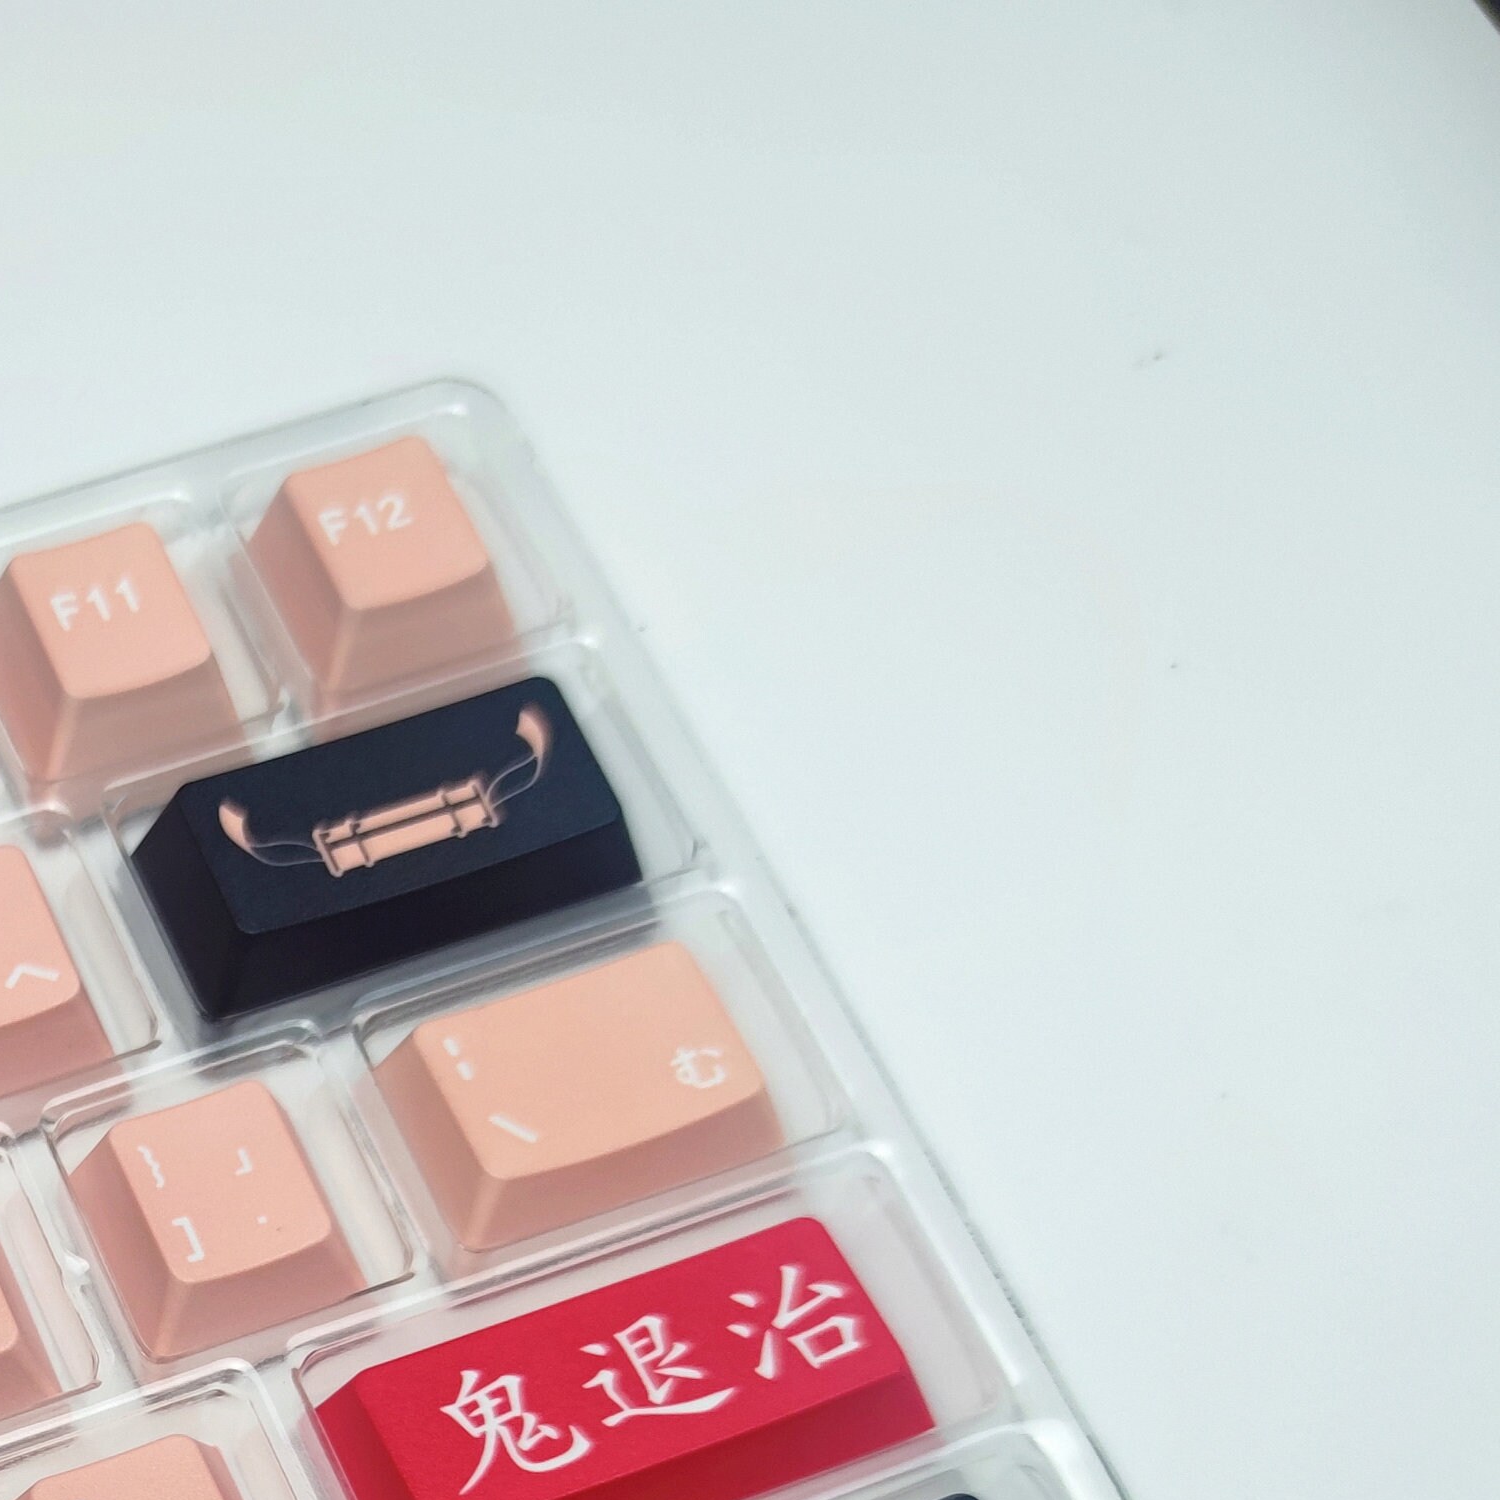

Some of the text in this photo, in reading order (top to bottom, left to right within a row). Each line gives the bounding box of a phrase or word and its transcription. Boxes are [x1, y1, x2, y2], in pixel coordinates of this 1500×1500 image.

[318, 494, 413, 546] F12
[50, 579, 141, 632] F11
[670, 1045, 728, 1089] む
[438, 1262, 871, 1496] 鬼退治
